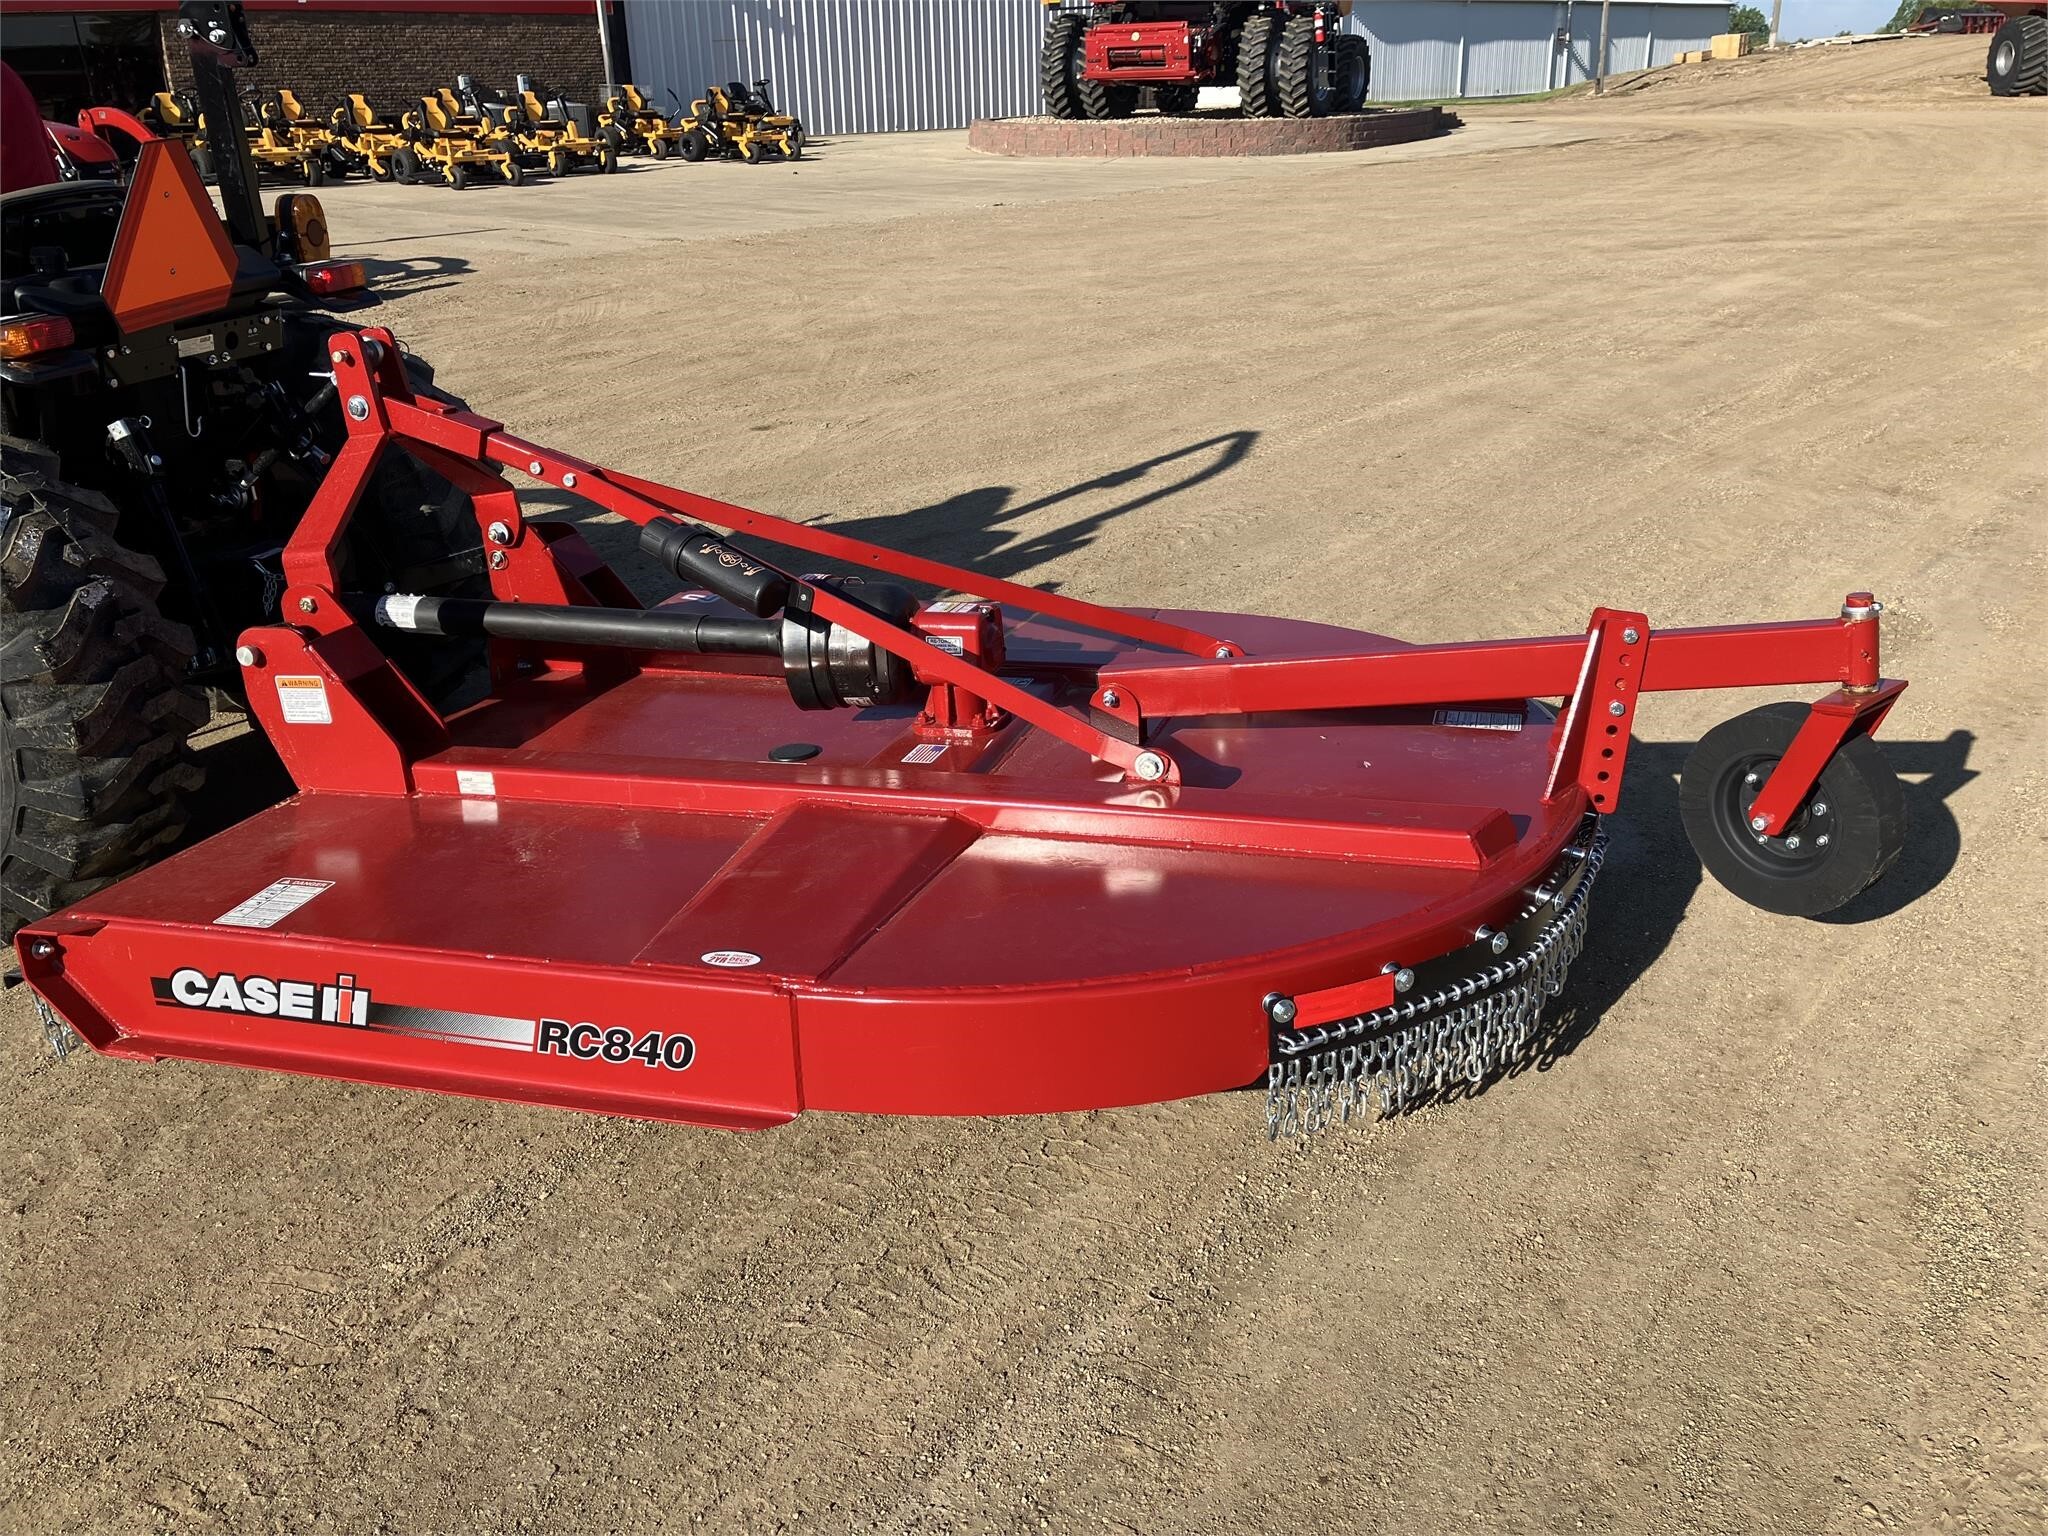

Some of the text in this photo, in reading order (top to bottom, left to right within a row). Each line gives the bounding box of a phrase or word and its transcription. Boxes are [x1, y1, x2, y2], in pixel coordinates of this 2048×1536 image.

[288, 679, 319, 687] WARNING
[171, 969, 315, 1020] CASE
[537, 1018, 696, 1072] RC840
